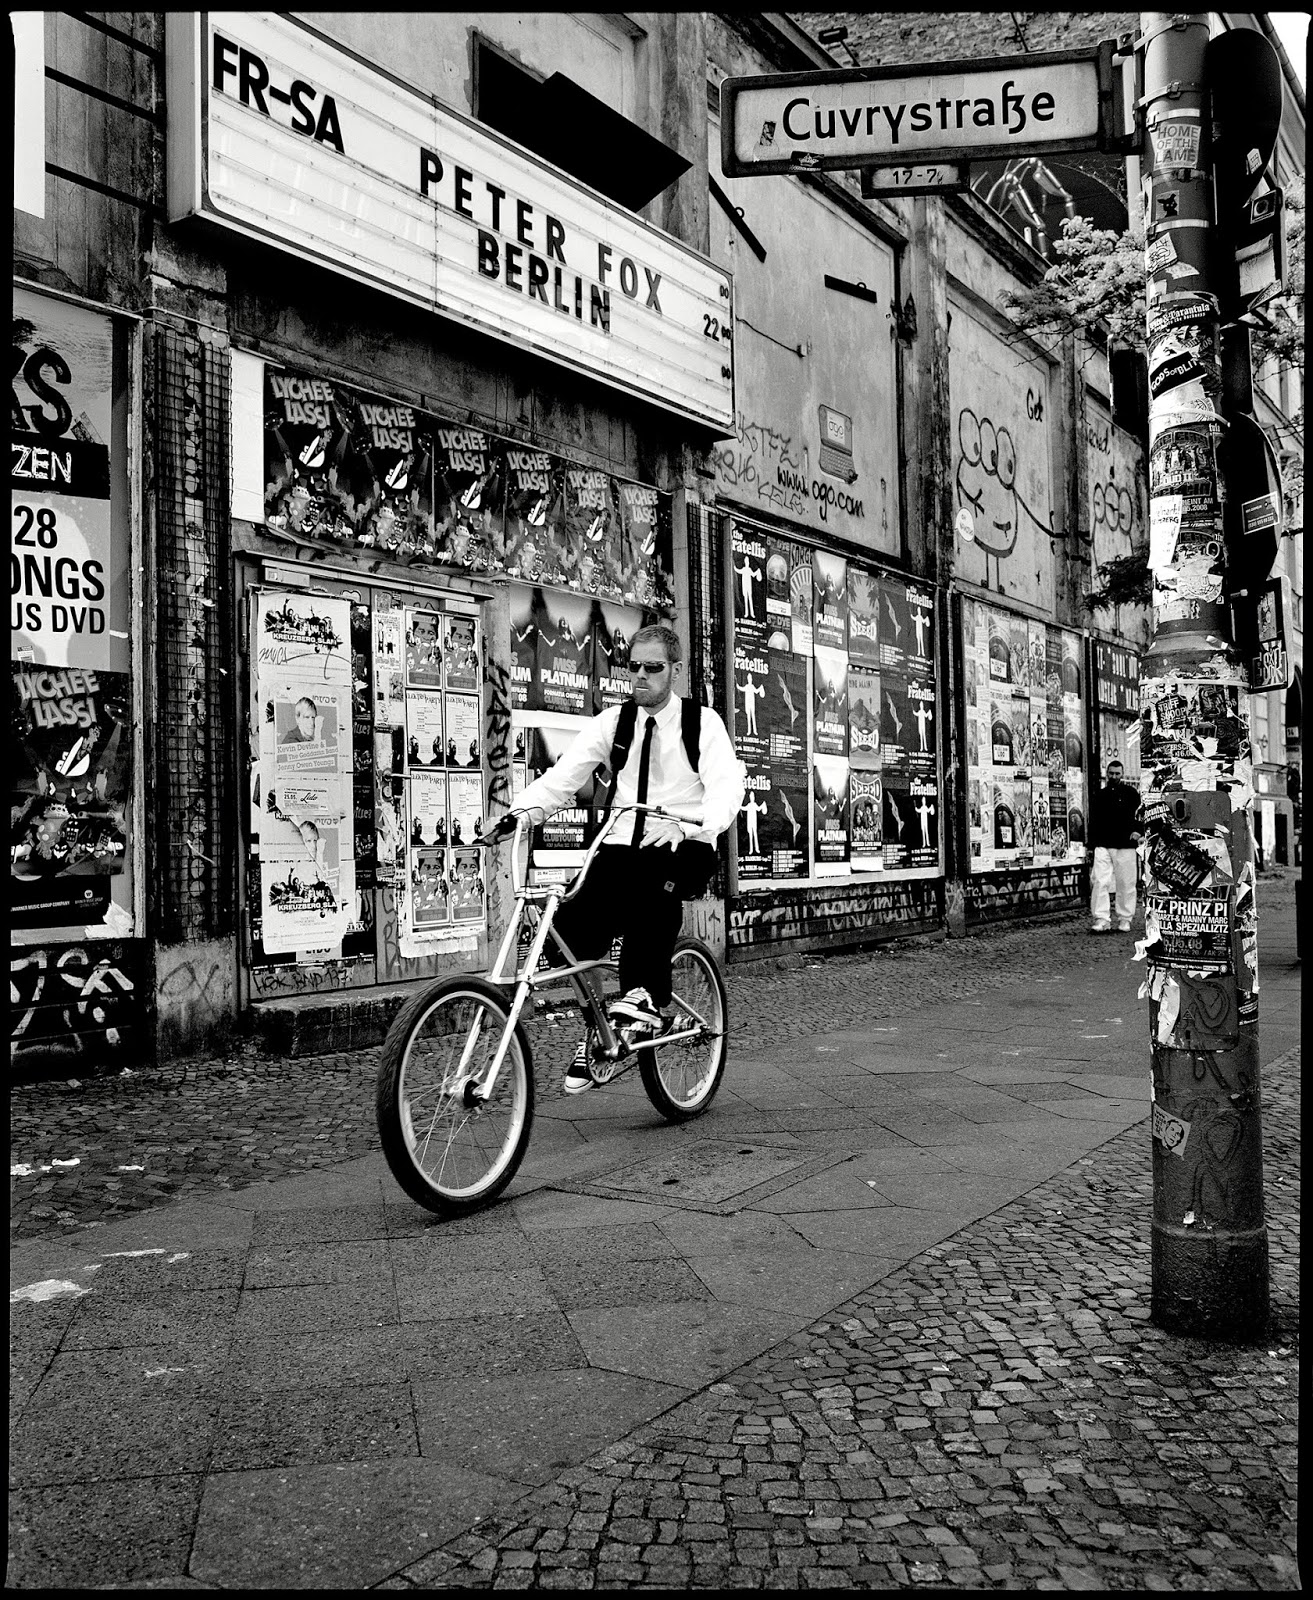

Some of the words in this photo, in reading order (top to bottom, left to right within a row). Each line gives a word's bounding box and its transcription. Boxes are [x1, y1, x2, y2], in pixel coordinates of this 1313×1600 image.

[212, 31, 347, 156] FR-SA
[782, 80, 1056, 146] Cuvrystraße
[1157, 125, 1200, 139] HOME
[1157, 138, 1171, 150] OF
[1175, 137, 1198, 150] THE
[1155, 148, 1196, 165] LAME
[419, 146, 567, 266] PETER
[598, 242, 663, 316] FOX
[478, 228, 611, 334] BERLIN
[703, 313, 720, 342] 22
[270, 376, 334, 401] LYCHEE
[1151, 367, 1171, 391] GODS
[285, 399, 332, 429] LASSI
[359, 403, 416, 427] LYCHEE
[372, 426, 412, 453] LASSI
[438, 429, 487, 451] LYCHEE
[12, 444, 72, 484] ZEN
[449, 450, 486, 475] LASSI
[506, 451, 551, 471] LYCHEE
[517, 472, 549, 494] LASSI
[569, 470, 608, 489] LYCHEE
[578, 489, 606, 510] LASSI
[14, 505, 58, 549] 28
[732, 530, 743, 540] the
[732, 540, 766, 559] ratellis
[52, 605, 106, 634] DVD
[273, 632, 315, 643] KREUZBERG
[735, 647, 746, 657] the
[553, 657, 577, 673] MISS
[735, 656, 769, 675] ratellis
[14, 669, 100, 701] LYCHEE
[541, 668, 588, 689] PLATNUM
[599, 677, 633, 694] PLATNU
[32, 698, 98, 729] LASSI
[851, 725, 879, 749] SEEED
[277, 745, 296, 753] Kevin
[297, 743, 319, 751] Devine
[277, 763, 295, 771] Jenny
[742, 775, 771, 790] atellis
[850, 776, 882, 802] SEEED
[300, 792, 318, 804] Lido
[546, 808, 588, 823] ATNUM
[278, 903, 321, 912] KREUZBERG
[322, 902, 337, 910] SLA
[1169, 900, 1211, 916] PRINZ
[1214, 902, 1228, 917] PI
[1176, 923, 1228, 933] SPEZIALIZTZ
[1181, 915, 1207, 923] MANNY
[1208, 916, 1228, 924] MARC
